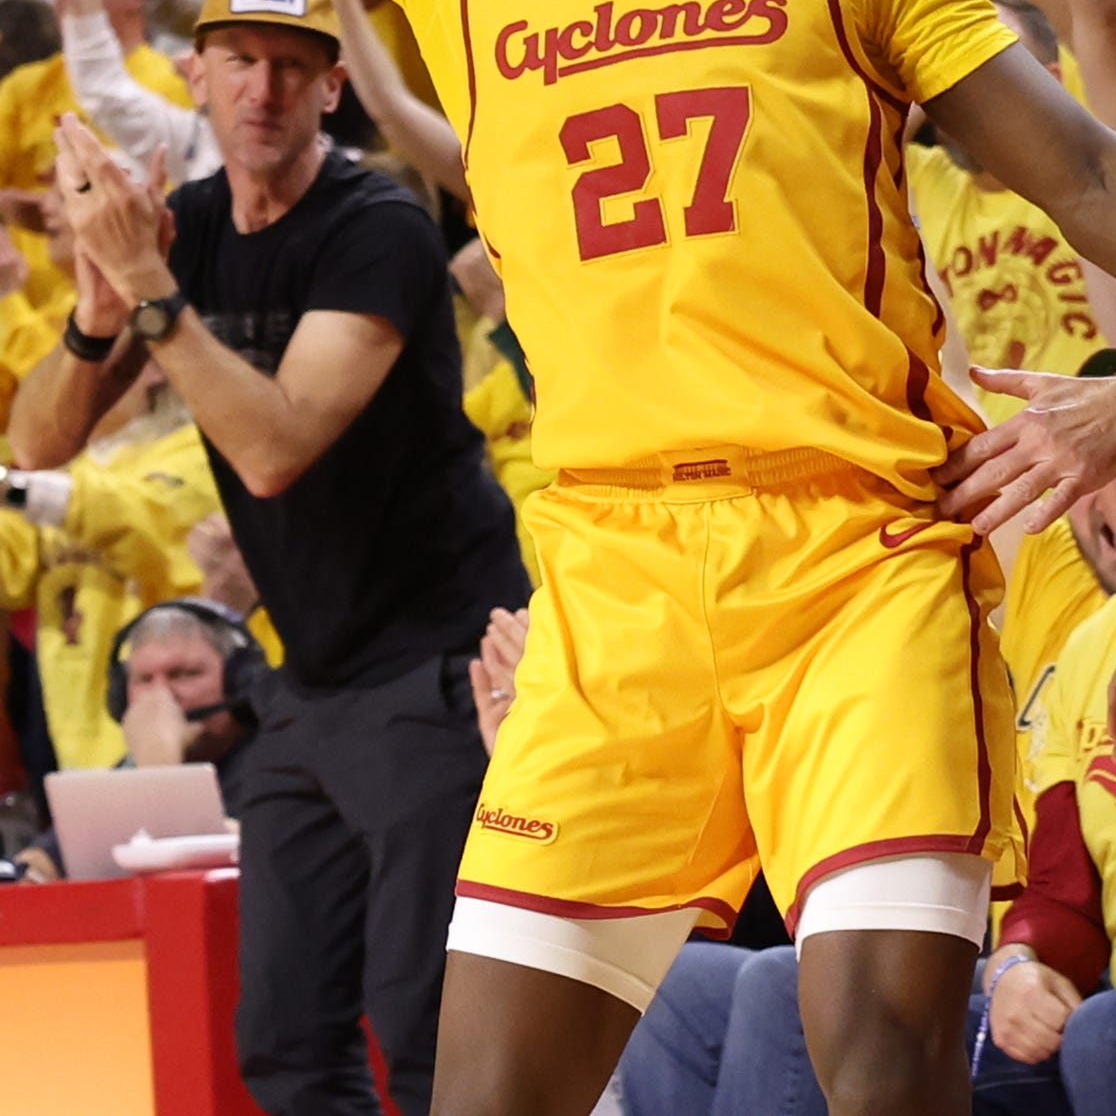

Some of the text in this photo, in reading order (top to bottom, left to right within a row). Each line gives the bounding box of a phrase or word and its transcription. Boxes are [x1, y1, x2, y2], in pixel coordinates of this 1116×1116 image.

[558, 86, 750, 262] 27
[1004, 225, 1097, 340] MAGIC
[476, 803, 554, 841] Cyclones
